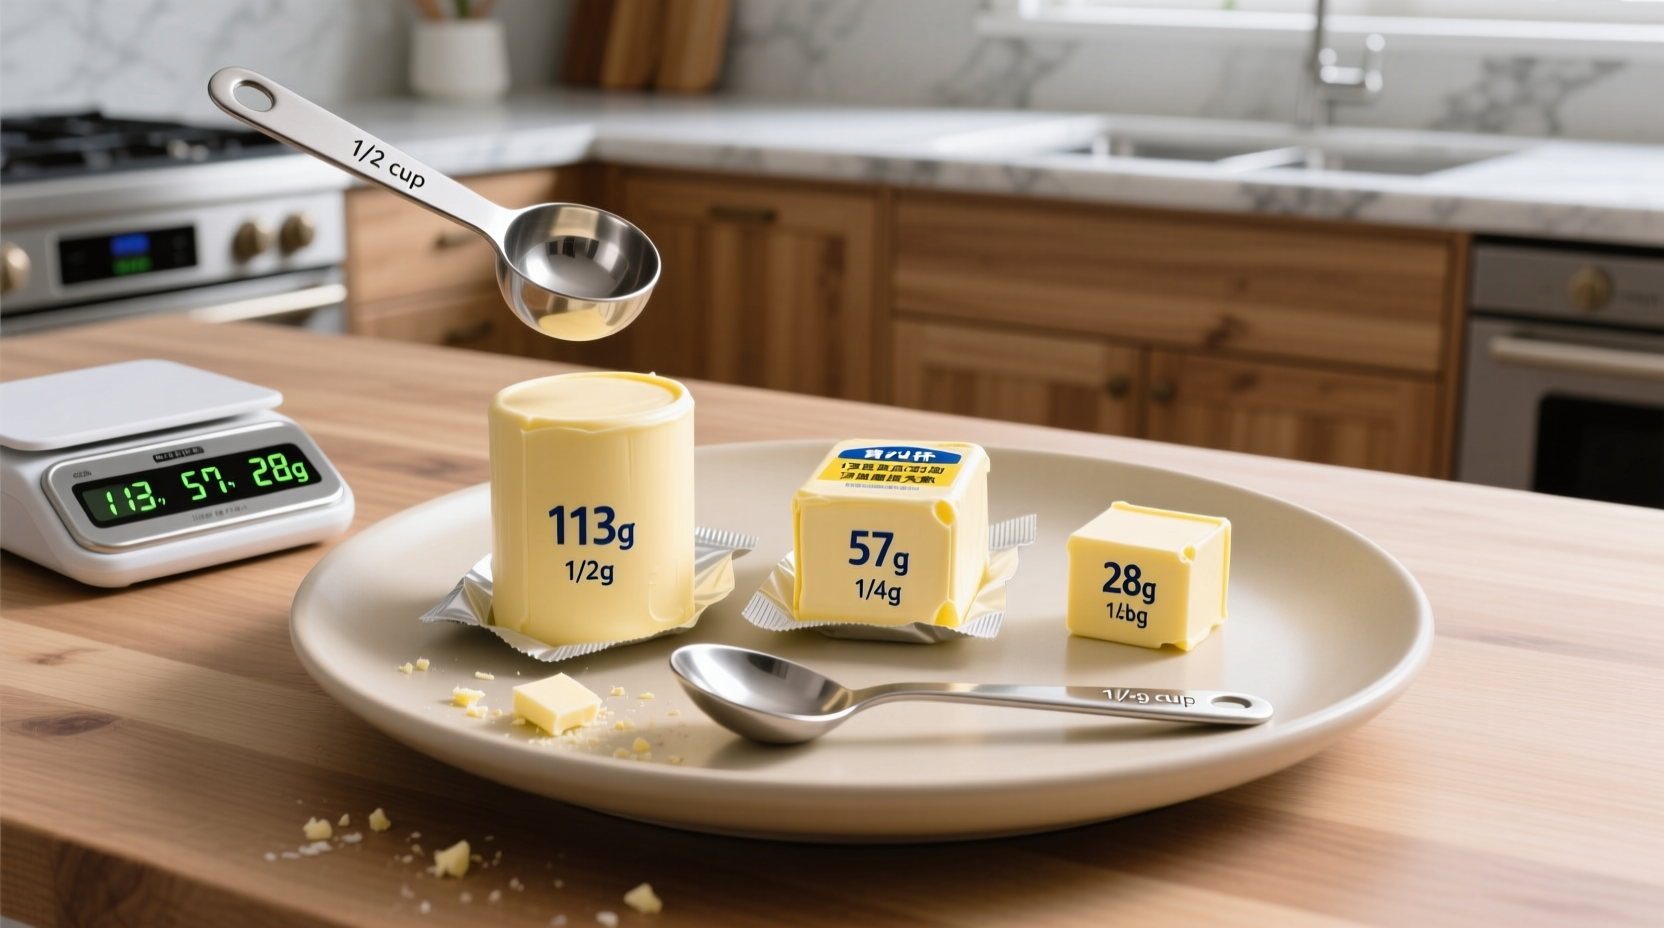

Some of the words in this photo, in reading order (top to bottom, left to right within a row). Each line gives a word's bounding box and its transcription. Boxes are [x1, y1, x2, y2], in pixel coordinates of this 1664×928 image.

[353, 139, 385, 169] 1/2
[389, 162, 425, 189] cup
[248, 452, 309, 487] 28g
[548, 505, 636, 551] 113g
[848, 529, 909, 576] 57g
[565, 559, 615, 586] 1/2g
[855, 578, 902, 606] 1/4g
[1102, 561, 1157, 605] 28g
[1154, 693, 1196, 708] cup
